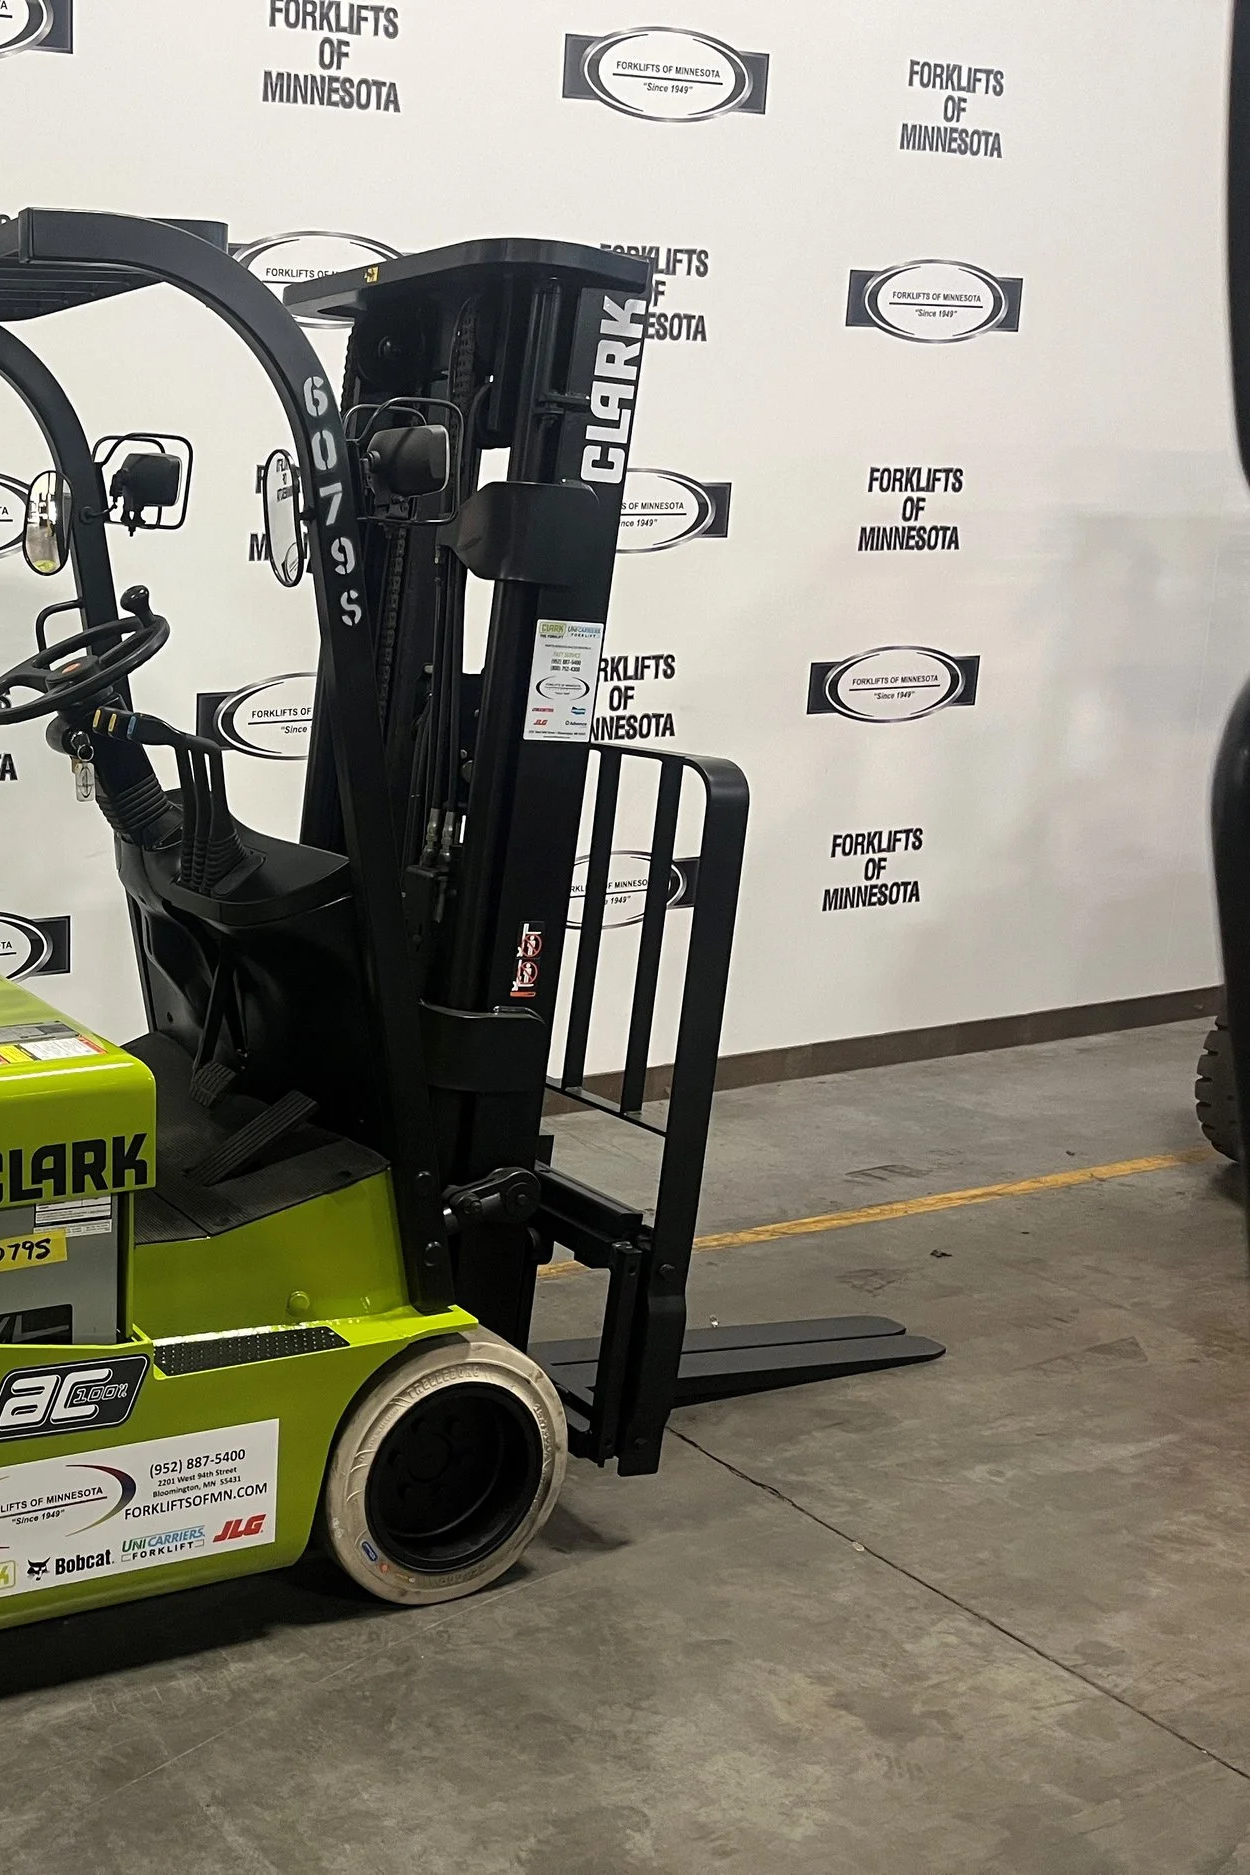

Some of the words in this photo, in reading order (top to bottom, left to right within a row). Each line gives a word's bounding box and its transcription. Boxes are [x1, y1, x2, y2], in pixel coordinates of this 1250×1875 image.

[268, 0, 399, 39] FORKLIFTS
[319, 36, 350, 70] OF
[616, 61, 661, 73] FORKLIFTS
[662, 65, 674, 74] OF
[675, 66, 721, 78] MINNESOTA
[908, 59, 1004, 97] FORKLIFTS
[262, 69, 401, 113] MINNESOTA
[943, 94, 967, 123] OF
[899, 122, 1002, 158] MINNESOTA
[265, 268, 315, 279] FORKLIFTS
[892, 291, 930, 301] FORKLIFTS
[932, 293, 941, 301] OF
[943, 293, 981, 303] MINNESOTA
[580, 295, 647, 484] CLARK
[867, 466, 964, 493] FORKLIFTS
[628, 502, 639, 510] OF
[640, 502, 684, 510] MINNESOTA
[901, 495, 926, 522] OF
[857, 525, 959, 552] MINNESOTA
[852, 678, 888, 686] FORKLIFTS
[901, 675, 938, 683] MINNESOTA
[609, 685, 634, 711] OF
[251, 708, 298, 718] FORKLIFTS
[300, 707, 311, 716] OF
[830, 828, 923, 858] FORKLIFTS
[863, 857, 888, 882] OF
[821, 880, 920, 912] MINNESOTA
[150, 1459, 183, 1479] (952)
[187, 1449, 246, 1470] 887-5400
[157, 1478, 175, 1487] 2201
[177, 1474, 196, 1483] West
[197, 1471, 214, 1480] 94th
[215, 1466, 237, 1476] Street
[30, 1497, 44, 1508] OF
[46, 1486, 103, 1505] MINNESOTA
[124, 1482, 268, 1520] FORKLIFTSOFMN.COM
[153, 1484, 201, 1498] Bloomington,
[203, 1480, 216, 1488] MN
[212, 1514, 267, 1543] JLG
[55, 1549, 111, 1576] Bobcat
[132, 1541, 194, 1561] FORKLIFT
